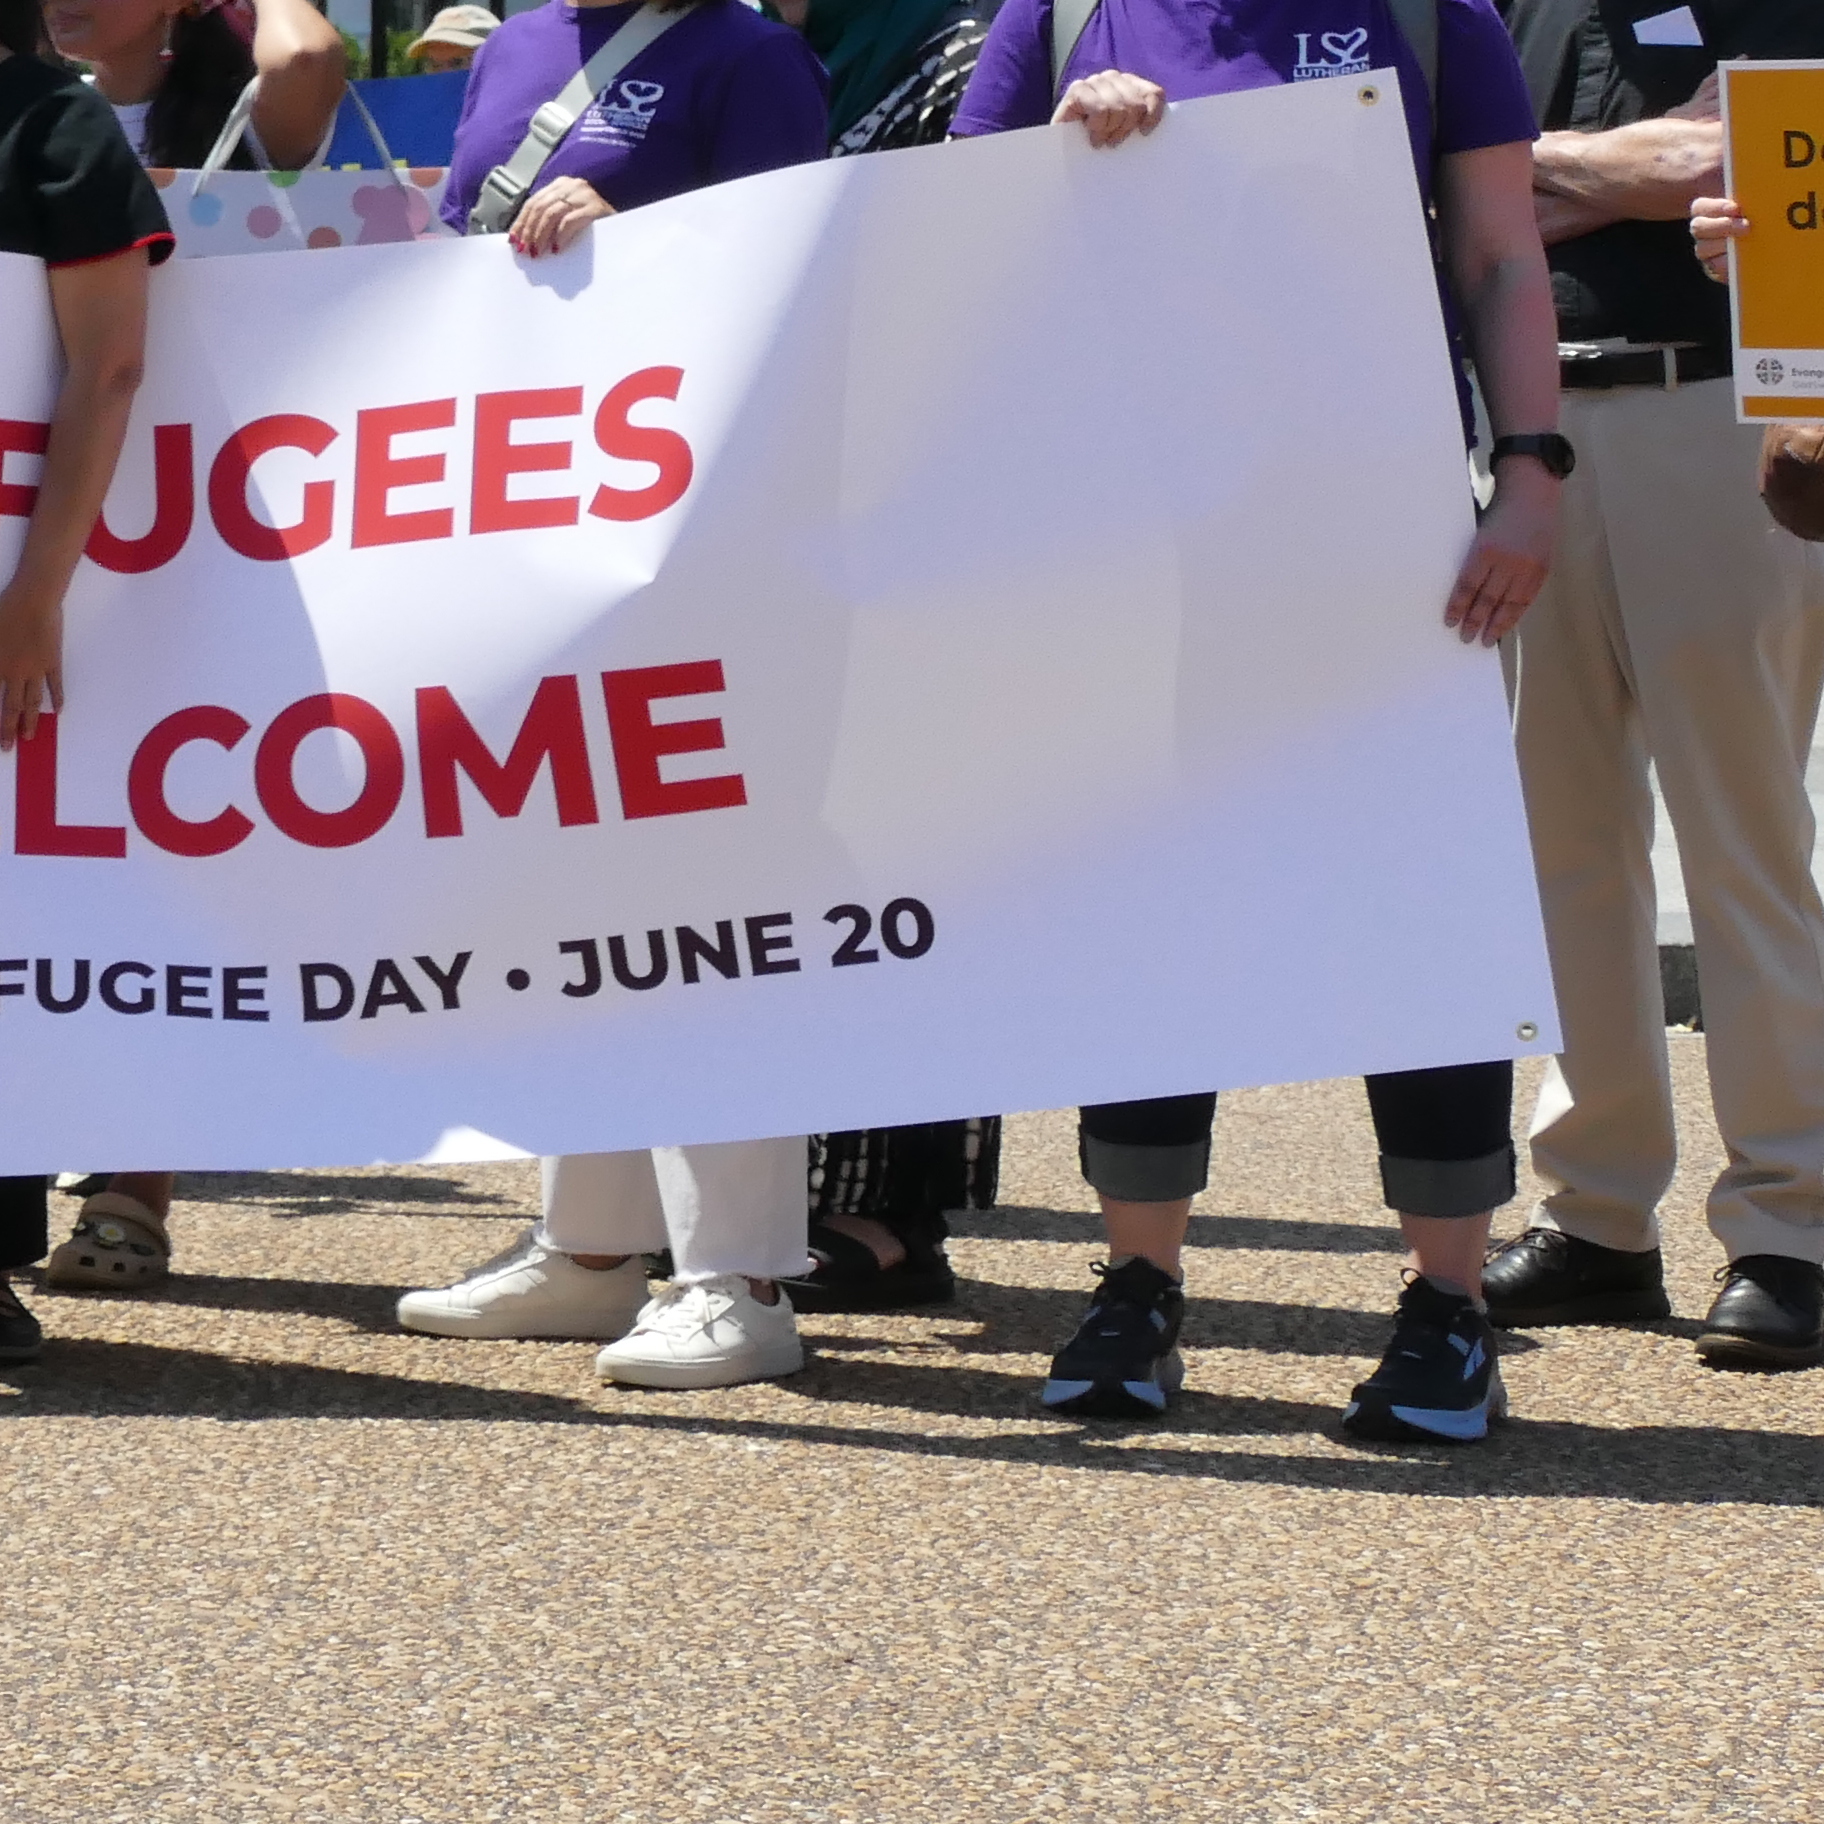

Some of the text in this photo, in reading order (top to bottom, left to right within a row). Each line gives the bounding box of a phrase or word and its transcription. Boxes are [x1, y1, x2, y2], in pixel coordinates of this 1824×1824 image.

[1783, 130, 1824, 169] D
[299, 950, 476, 1023] DAY
[558, 911, 799, 1000] JUNE
[824, 896, 937, 972] 20
